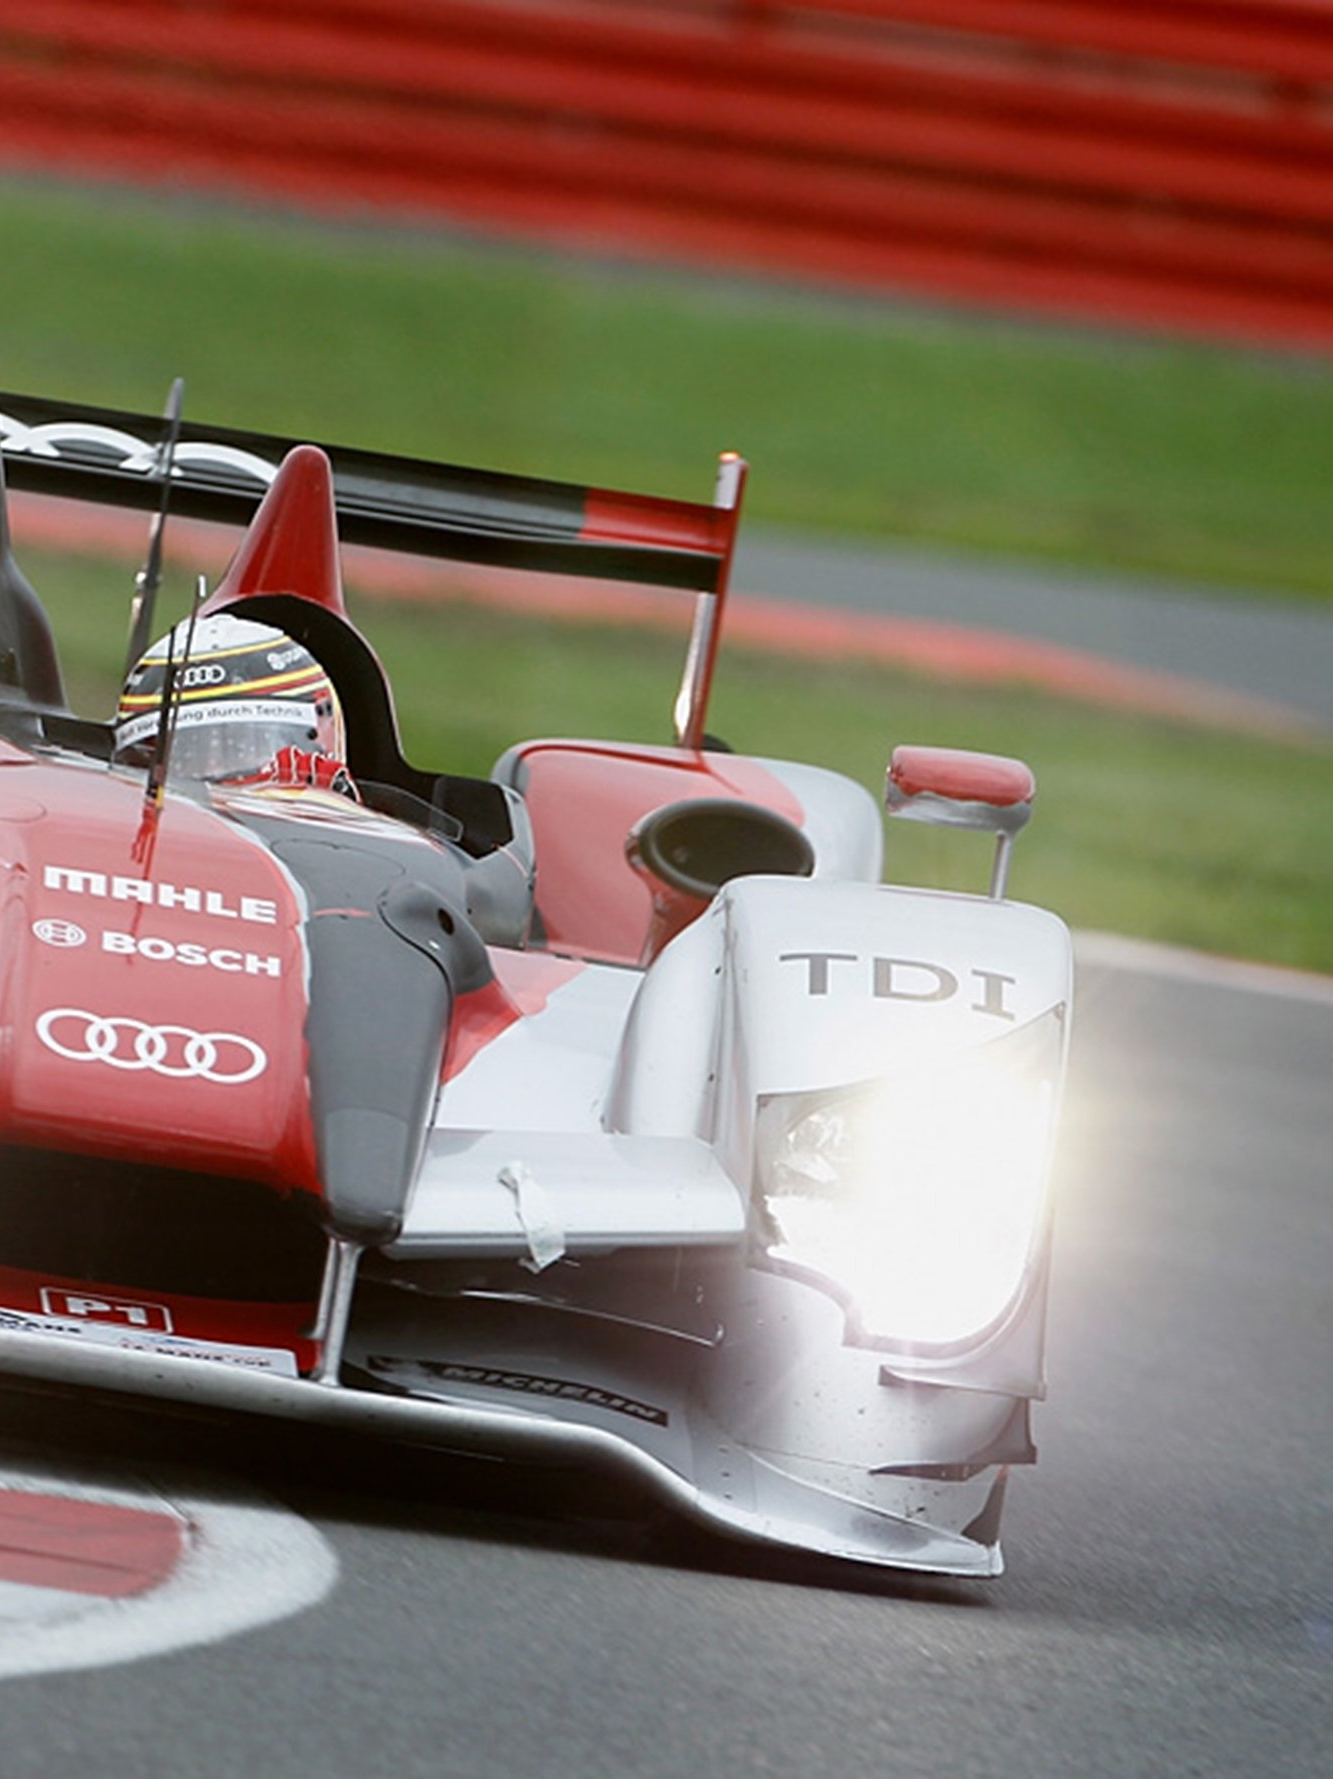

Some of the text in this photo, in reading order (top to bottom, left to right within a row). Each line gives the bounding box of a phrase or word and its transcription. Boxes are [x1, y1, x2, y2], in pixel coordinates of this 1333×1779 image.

[43, 864, 277, 924] MAHLE
[102, 930, 281, 977] BOSCH
[779, 952, 1016, 1021] TDI
[66, 1296, 149, 1326] P1
[442, 1366, 661, 1420] MICHELIN
